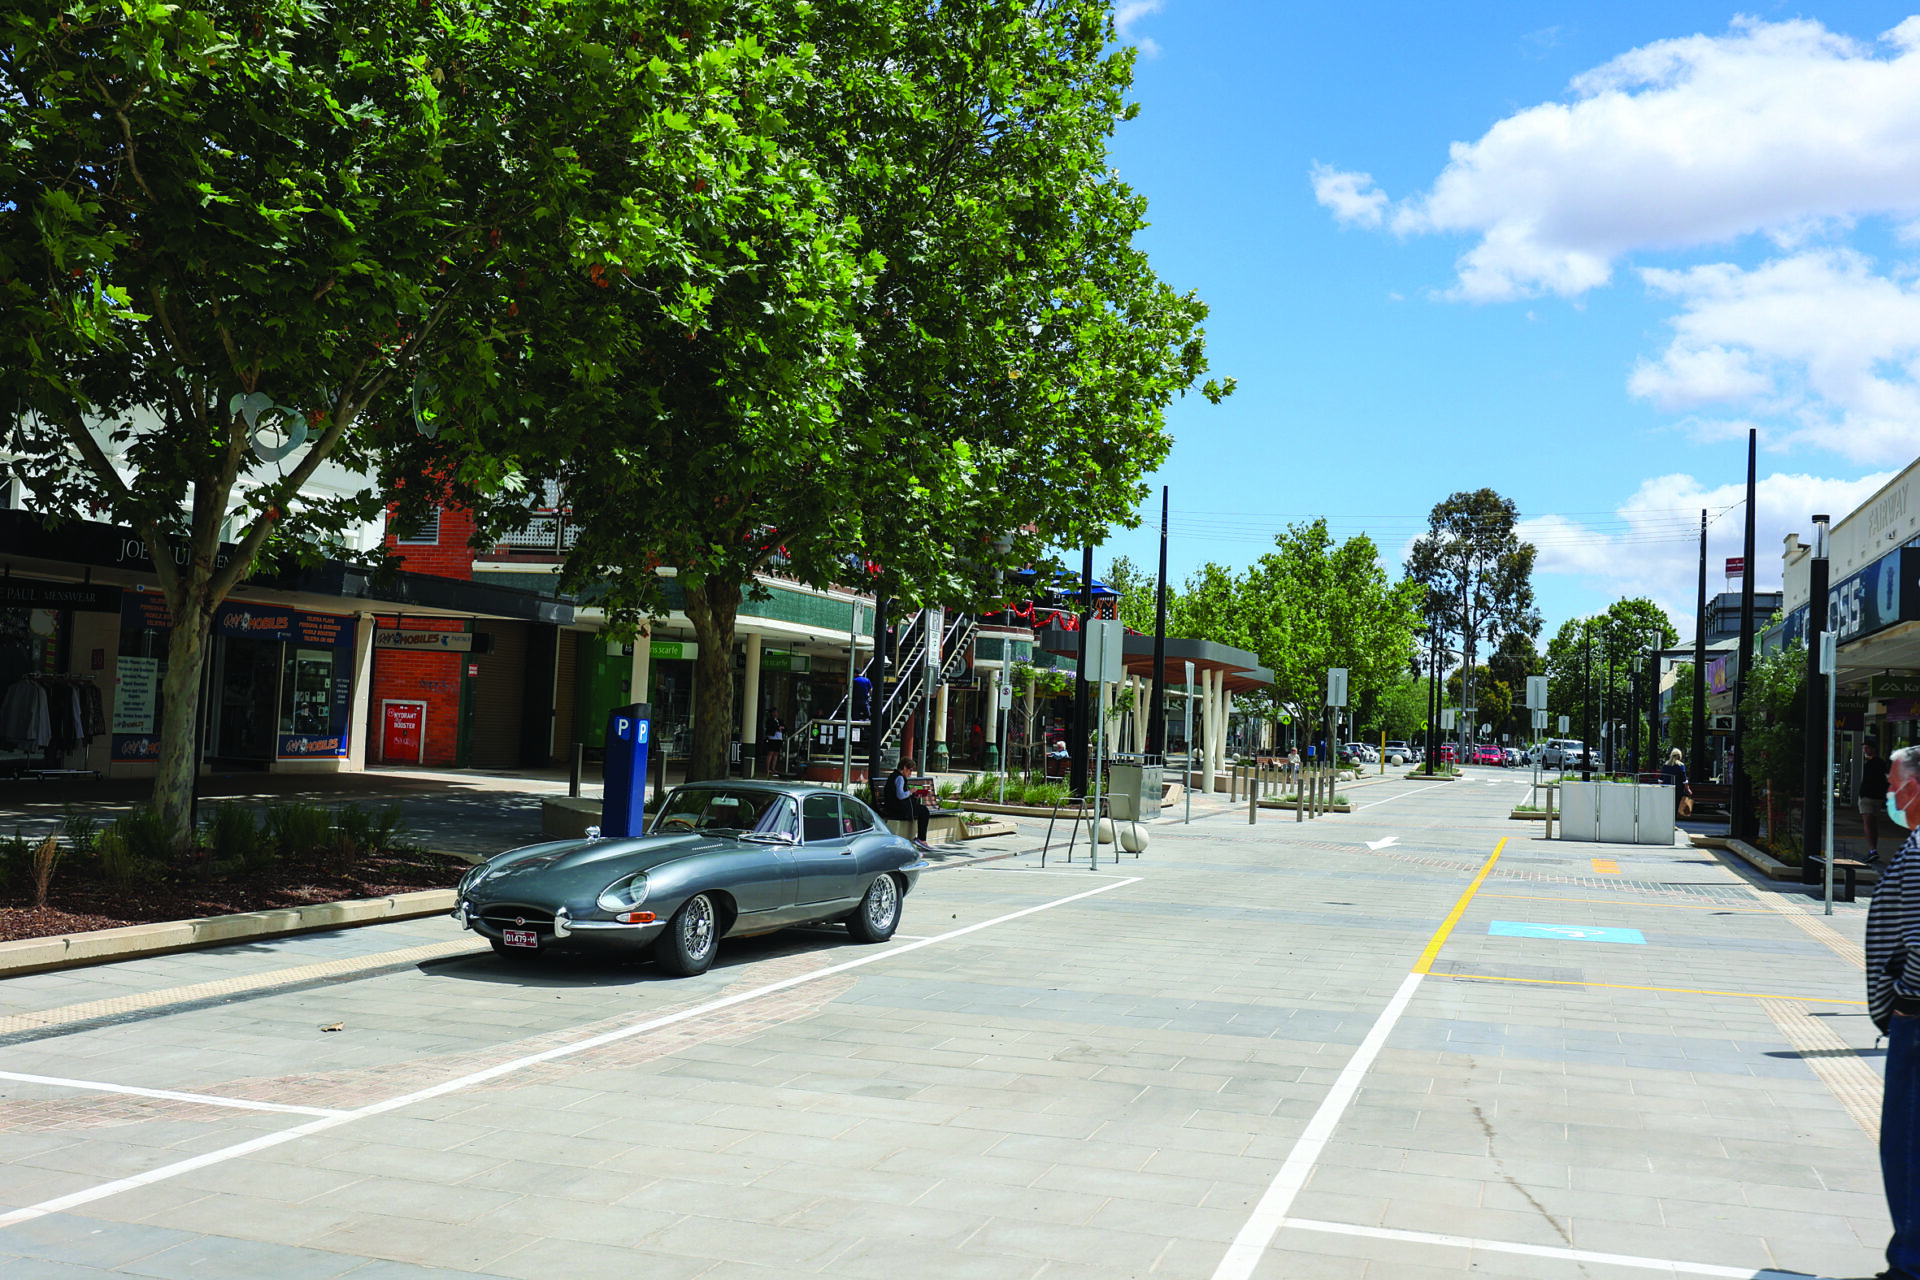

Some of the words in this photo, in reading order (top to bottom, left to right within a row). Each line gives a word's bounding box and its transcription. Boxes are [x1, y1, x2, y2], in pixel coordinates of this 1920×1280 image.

[117, 538, 149, 562] JOE
[7, 587, 37, 601] PAUL
[43, 591, 96, 602] MENSWEAR
[248, 617, 288, 629] MOBILES
[400, 634, 439, 645] MOBILES
[659, 646, 679, 654] scarfe
[1904, 683, 1920, 692] Ka
[618, 718, 629, 736] P
[640, 723, 647, 741] P
[305, 738, 338, 752] MOBILES
